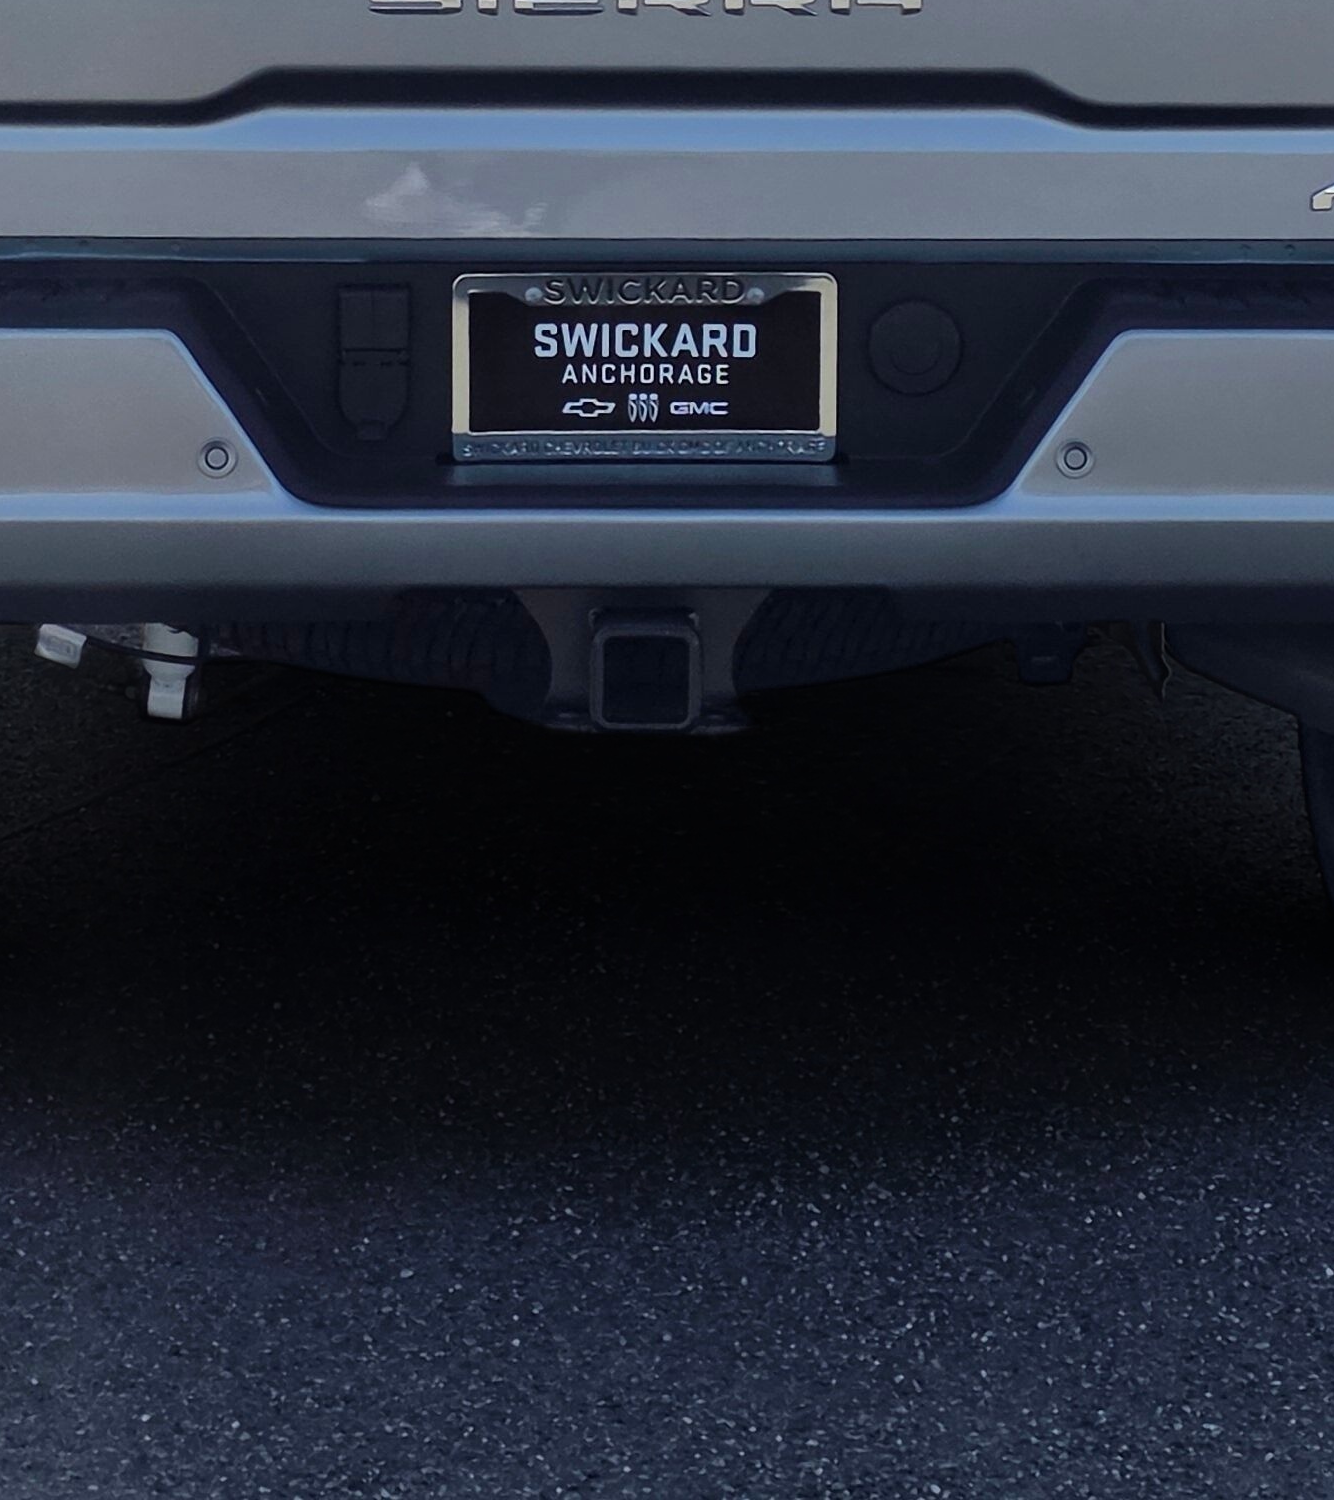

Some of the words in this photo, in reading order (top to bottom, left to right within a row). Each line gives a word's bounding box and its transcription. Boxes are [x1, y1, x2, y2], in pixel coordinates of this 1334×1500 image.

[542, 277, 746, 306] SWICKARD
[533, 323, 757, 359] SWICKARD
[561, 363, 730, 385] ANCHORAGE
[669, 401, 730, 416] GMC
